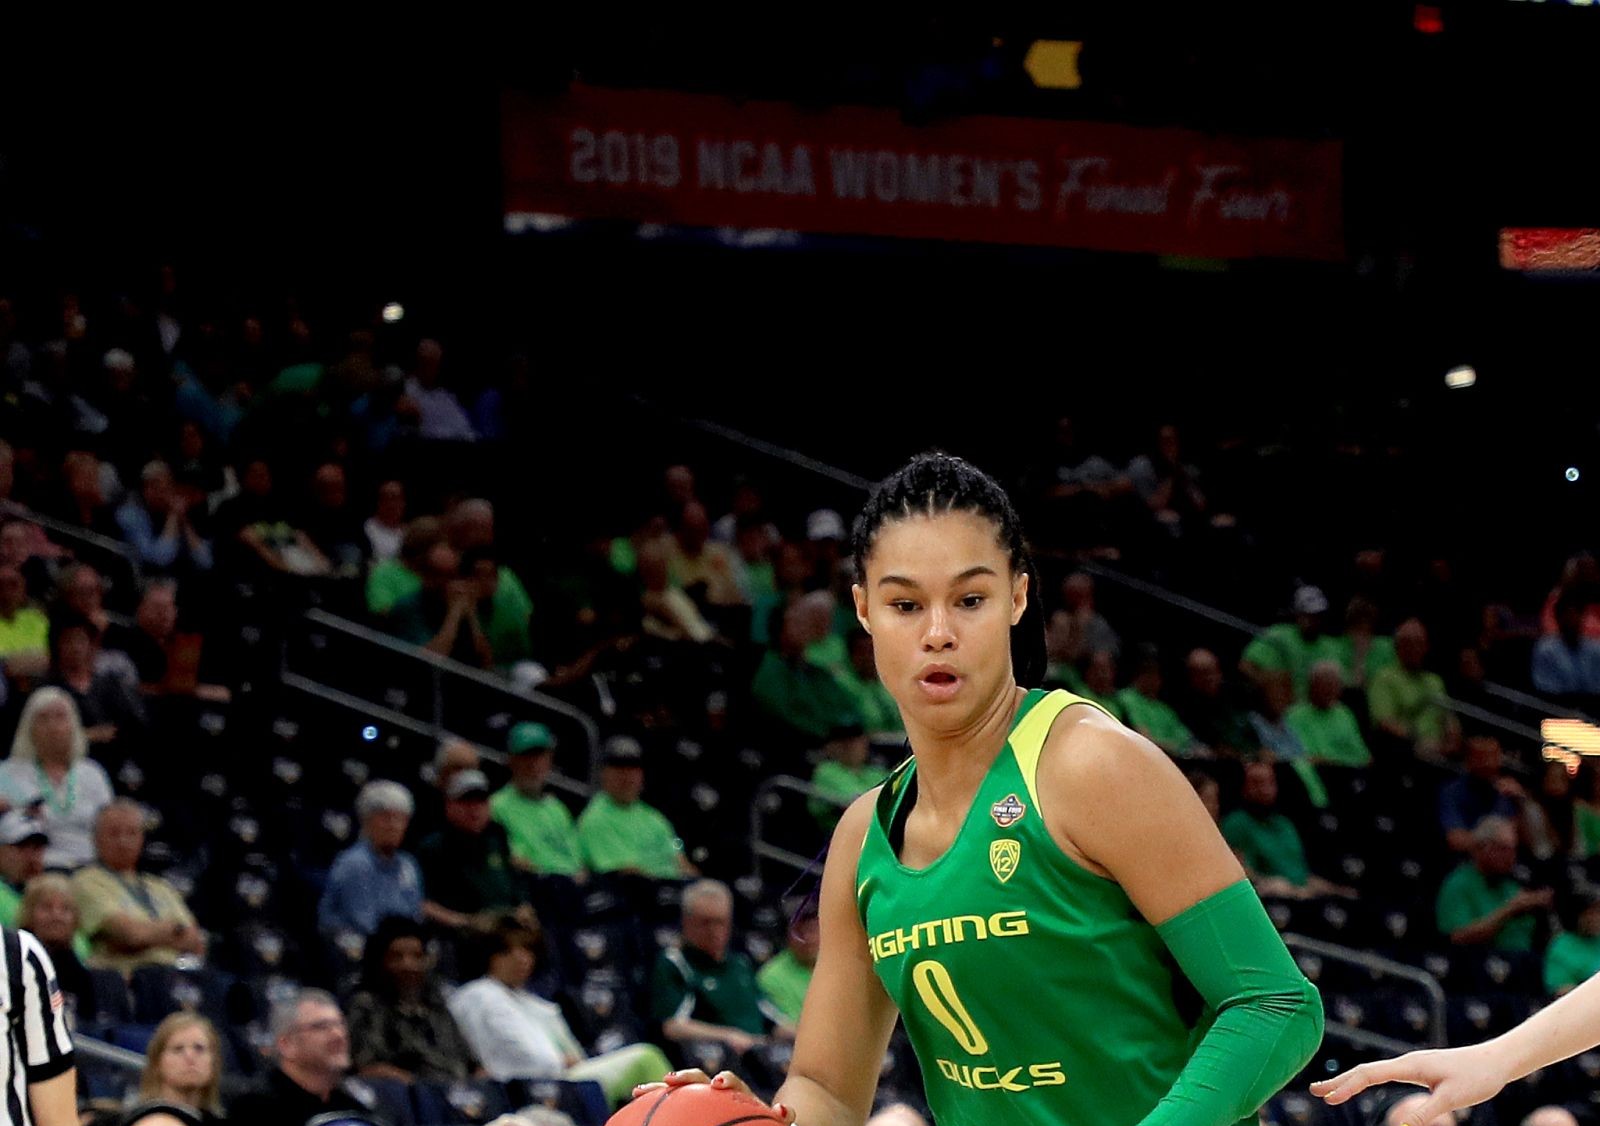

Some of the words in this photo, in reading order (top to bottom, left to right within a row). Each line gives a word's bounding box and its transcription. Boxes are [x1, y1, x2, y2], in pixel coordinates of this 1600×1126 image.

[569, 127, 682, 188] 2019
[696, 137, 816, 197] NCAA
[829, 146, 1040, 211] WOMEN'S
[996, 856, 1011, 873] 12
[913, 960, 989, 1056] 0
[936, 1059, 1066, 1092] DUCKS
